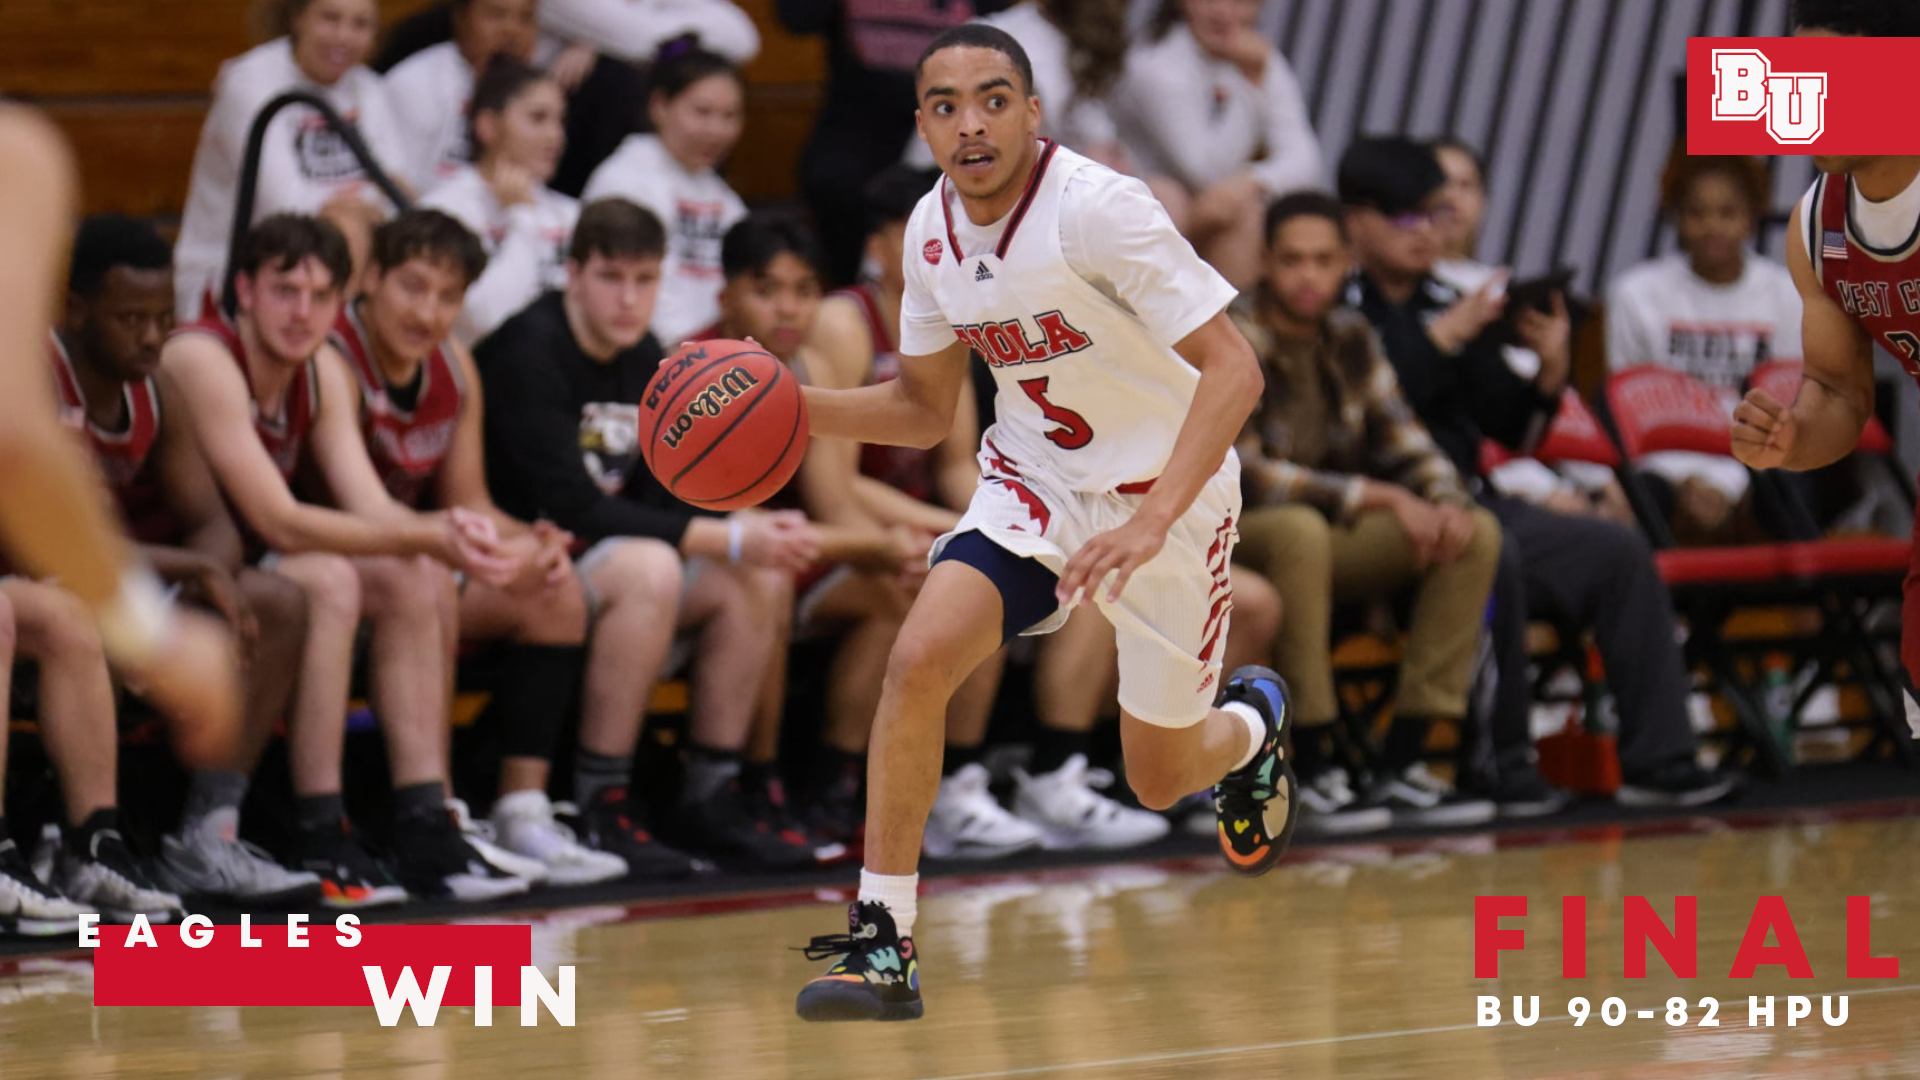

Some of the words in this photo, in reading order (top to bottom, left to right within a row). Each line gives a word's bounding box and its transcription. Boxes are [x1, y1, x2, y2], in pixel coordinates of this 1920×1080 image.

[646, 347, 708, 411] NCAA
[661, 366, 759, 449] Wilson
[1017, 375, 1094, 450] 5
